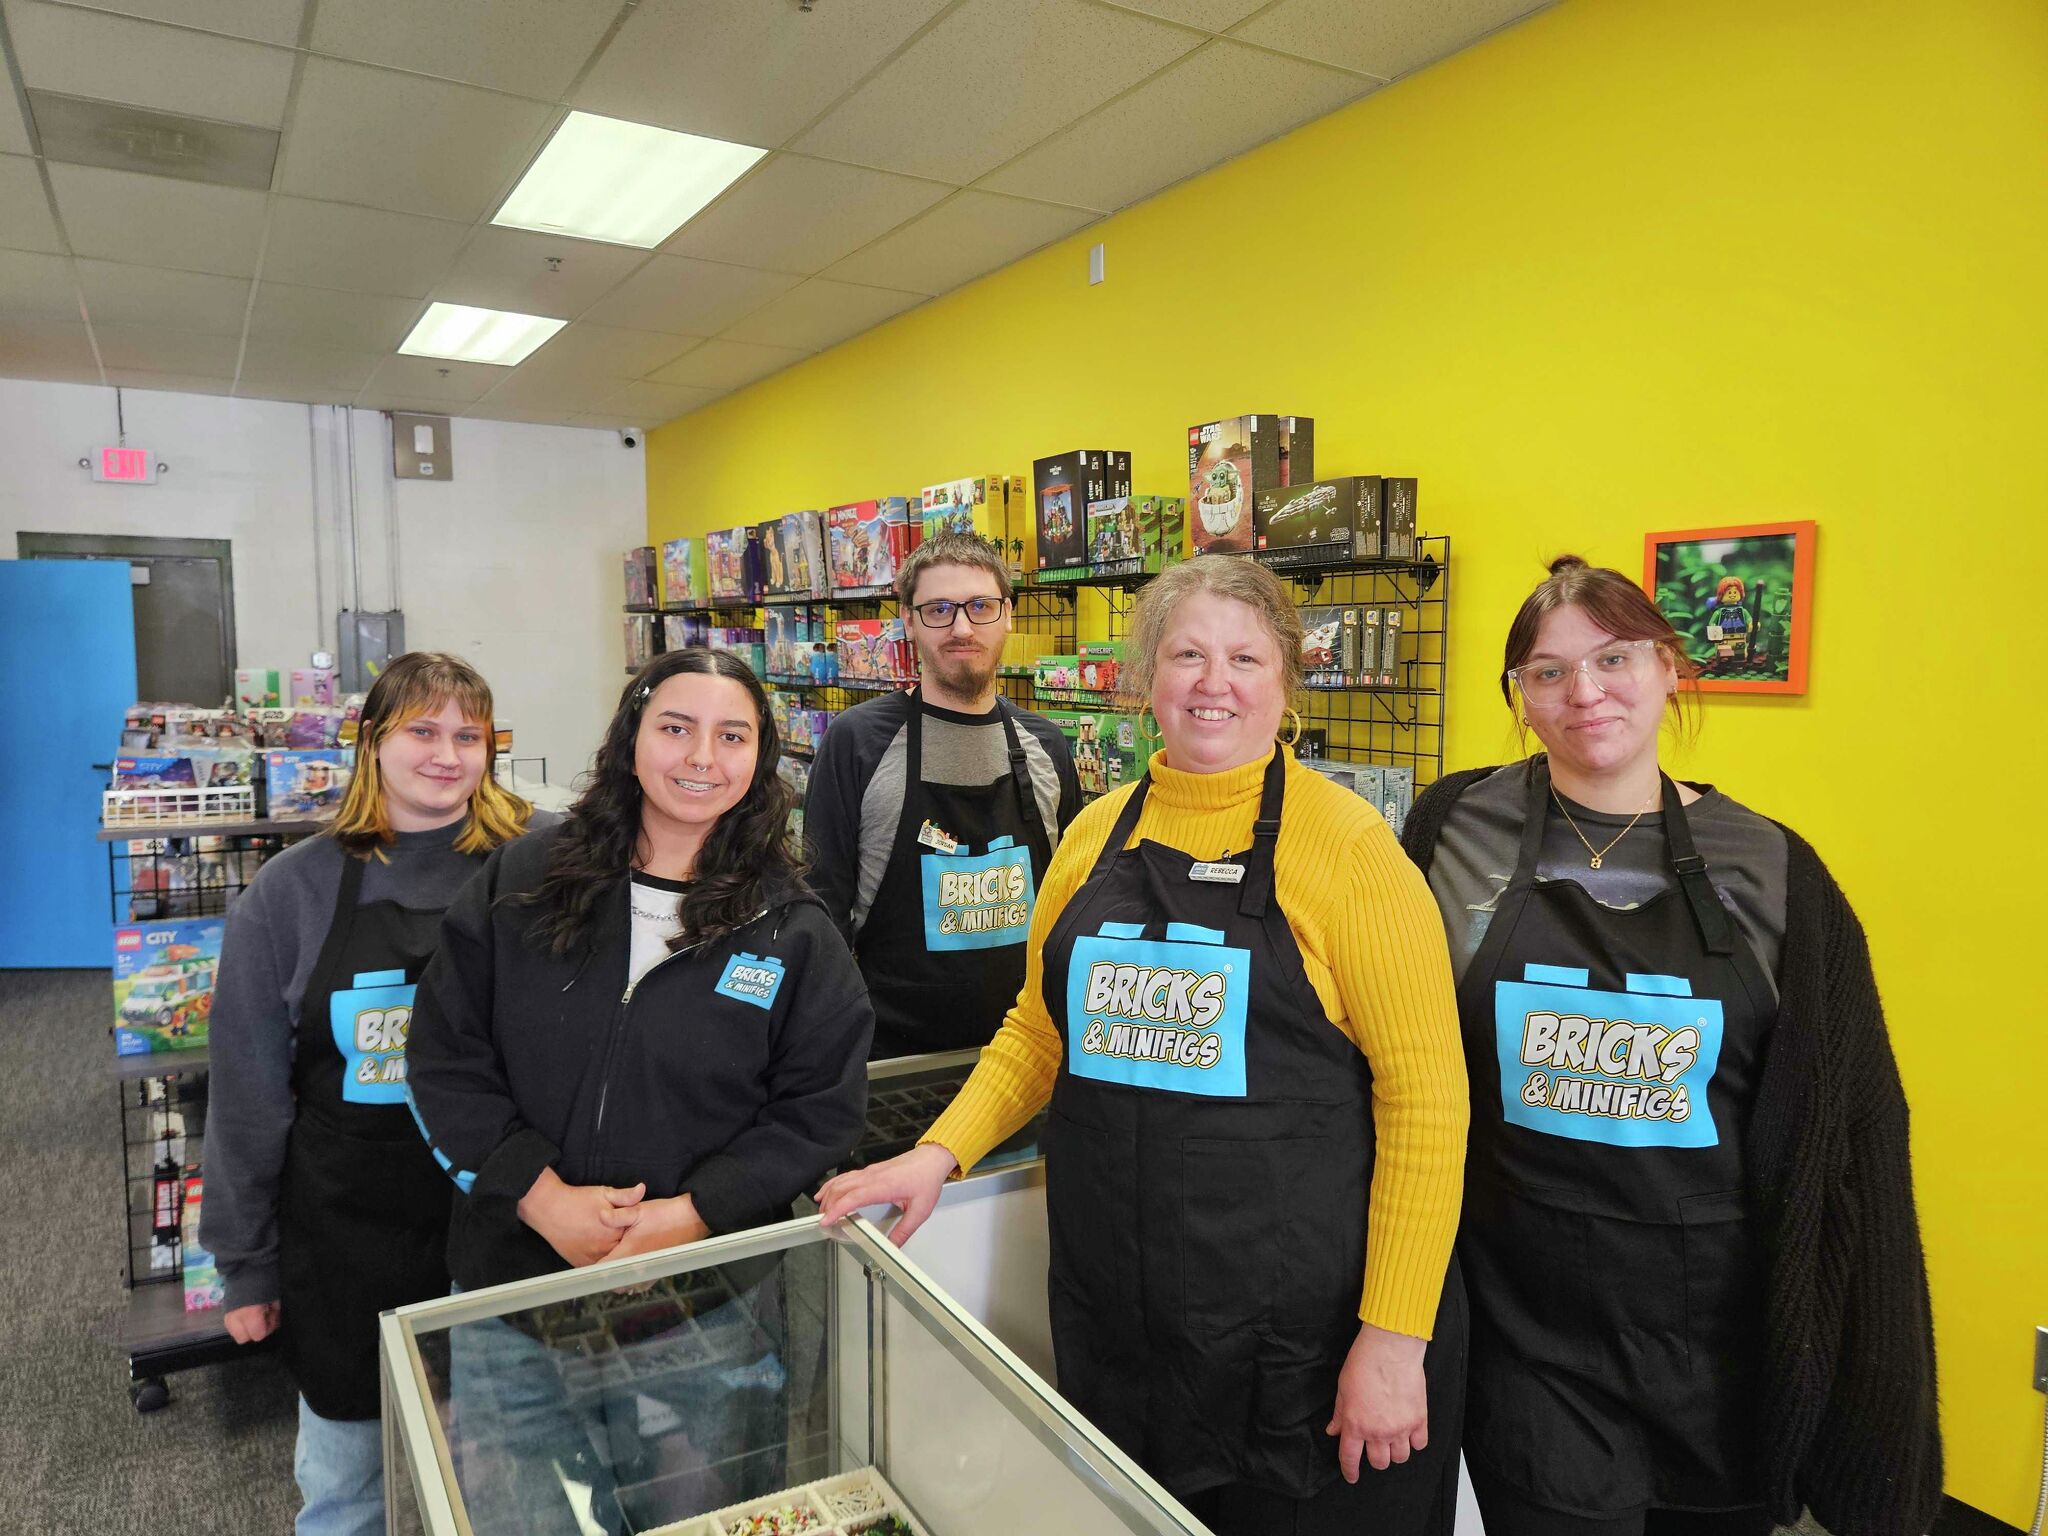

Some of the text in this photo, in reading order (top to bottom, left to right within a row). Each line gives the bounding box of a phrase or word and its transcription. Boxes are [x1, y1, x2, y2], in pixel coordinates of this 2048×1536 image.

[939, 864, 1025, 908] BRICKS
[1210, 867, 1238, 875] REBECCA
[941, 901, 1027, 935] & MINIFIGS
[146, 931, 177, 945] CITY
[724, 979, 770, 1000] & MINIFIGS
[730, 964, 777, 987] BRICKS
[1084, 961, 1226, 1029] BRICKS
[356, 1006, 413, 1053] BR
[1082, 1020, 1221, 1069] & MINIFIGS
[1520, 1011, 1700, 1085] BRICKS
[357, 1056, 406, 1084] & M
[1520, 1072, 1691, 1122] & MINIFIGS
